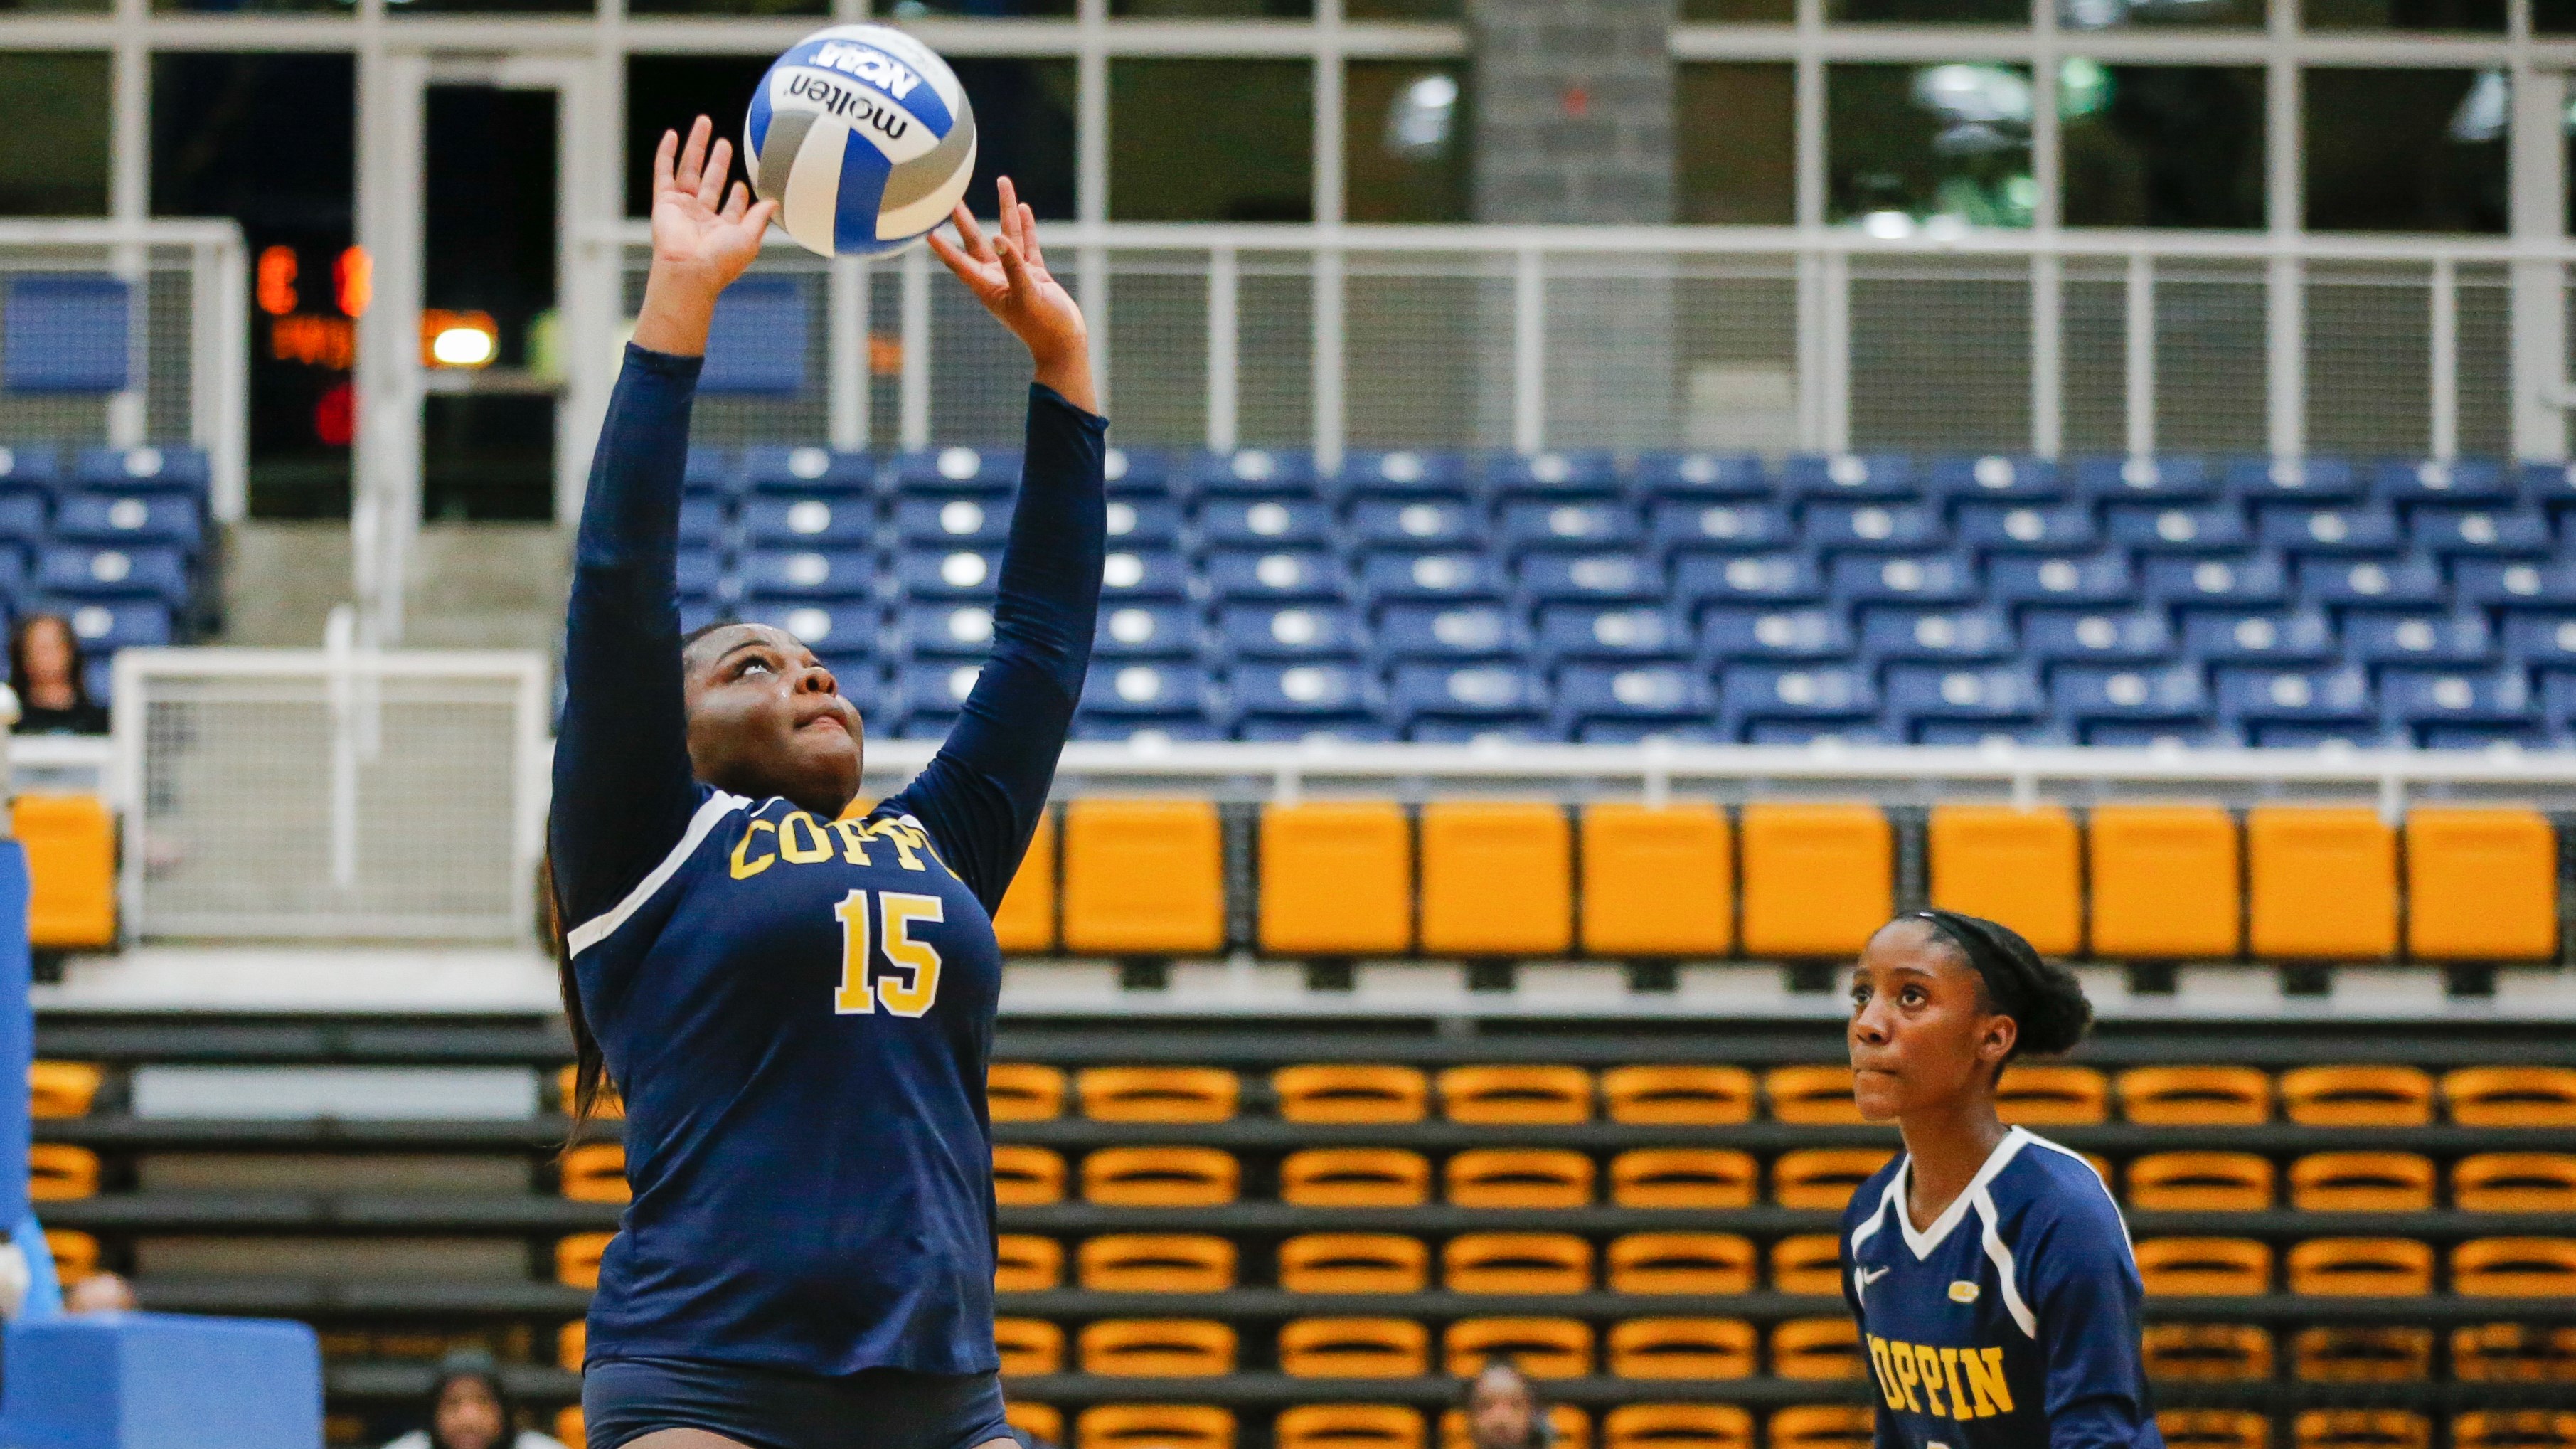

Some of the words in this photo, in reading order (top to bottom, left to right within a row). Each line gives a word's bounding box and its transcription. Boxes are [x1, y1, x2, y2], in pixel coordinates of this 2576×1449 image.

[812, 41, 921, 100] NCAA
[789, 74, 908, 139] molten
[730, 811, 963, 881] COPP
[834, 888, 944, 1018] 15
[1866, 1333, 2016, 1421] OPPIN
